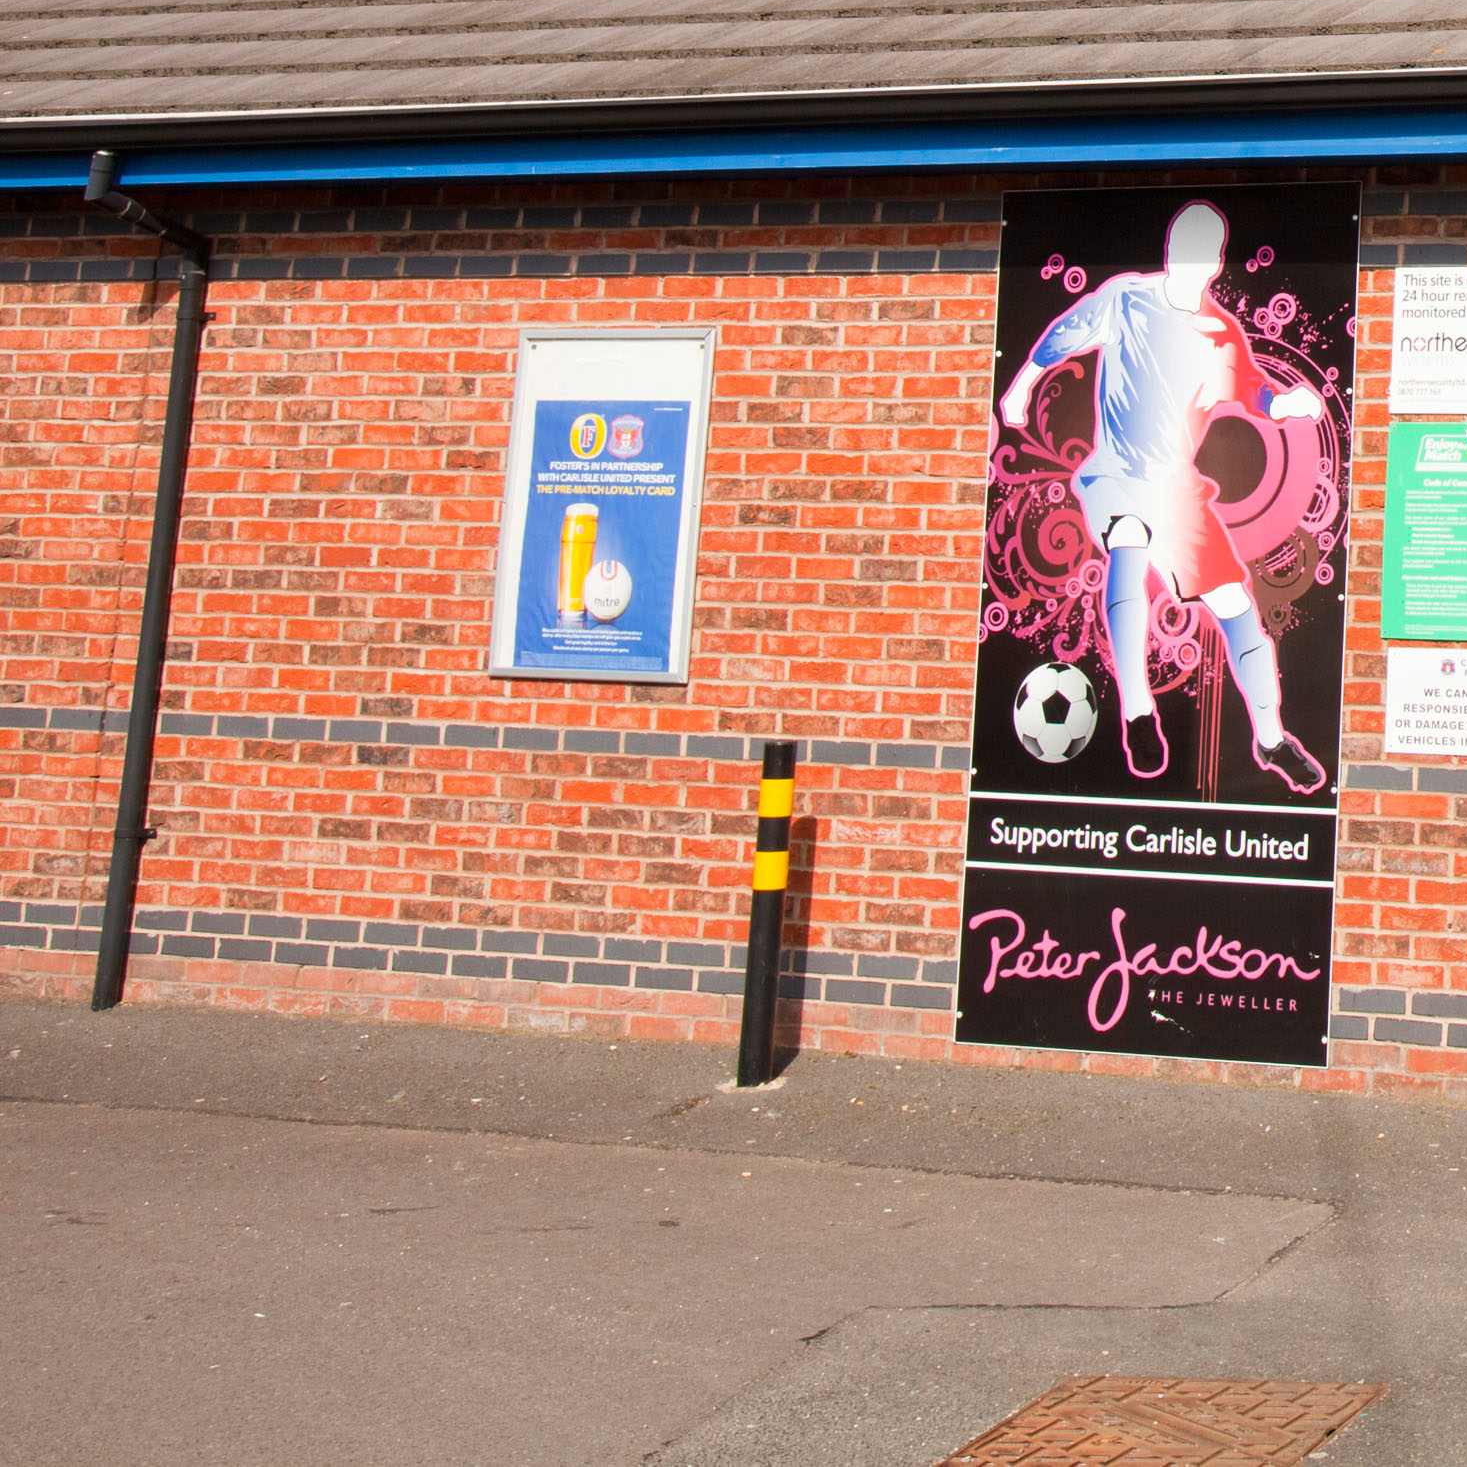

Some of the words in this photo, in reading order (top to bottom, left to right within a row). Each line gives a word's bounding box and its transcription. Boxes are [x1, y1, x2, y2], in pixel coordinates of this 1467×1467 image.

[1403, 274, 1427, 286] This
[1430, 274, 1451, 286] site
[1454, 274, 1464, 286] is
[1402, 290, 1417, 302] 24
[1421, 290, 1449, 302] hour
[1402, 306, 1466, 318] monitored
[550, 462, 590, 471] FOSTER'S
[591, 462, 600, 471] IN
[601, 462, 663, 472] PARTNERSHIP
[538, 473, 560, 482] WITH
[560, 473, 599, 483] CARLISLE
[600, 474, 632, 483] UNITED
[633, 474, 676, 484] PRESENT
[536, 485, 553, 494] THE
[605, 486, 646, 495] LOYALTY
[647, 486, 676, 496] CARD
[594, 597, 620, 607] mitre
[1424, 689, 1441, 698] WE
[1395, 720, 1411, 729] OR
[1415, 720, 1465, 731] DAMAGE
[1398, 736, 1456, 746] VEHICLES
[990, 817, 1118, 859] Supporting
[1126, 825, 1216, 856] Carlisle
[1225, 830, 1308, 861] United
[969, 908, 1100, 993] Peter
[1087, 907, 1321, 1032] Jackson
[1196, 993, 1298, 1011] JEWELLER
